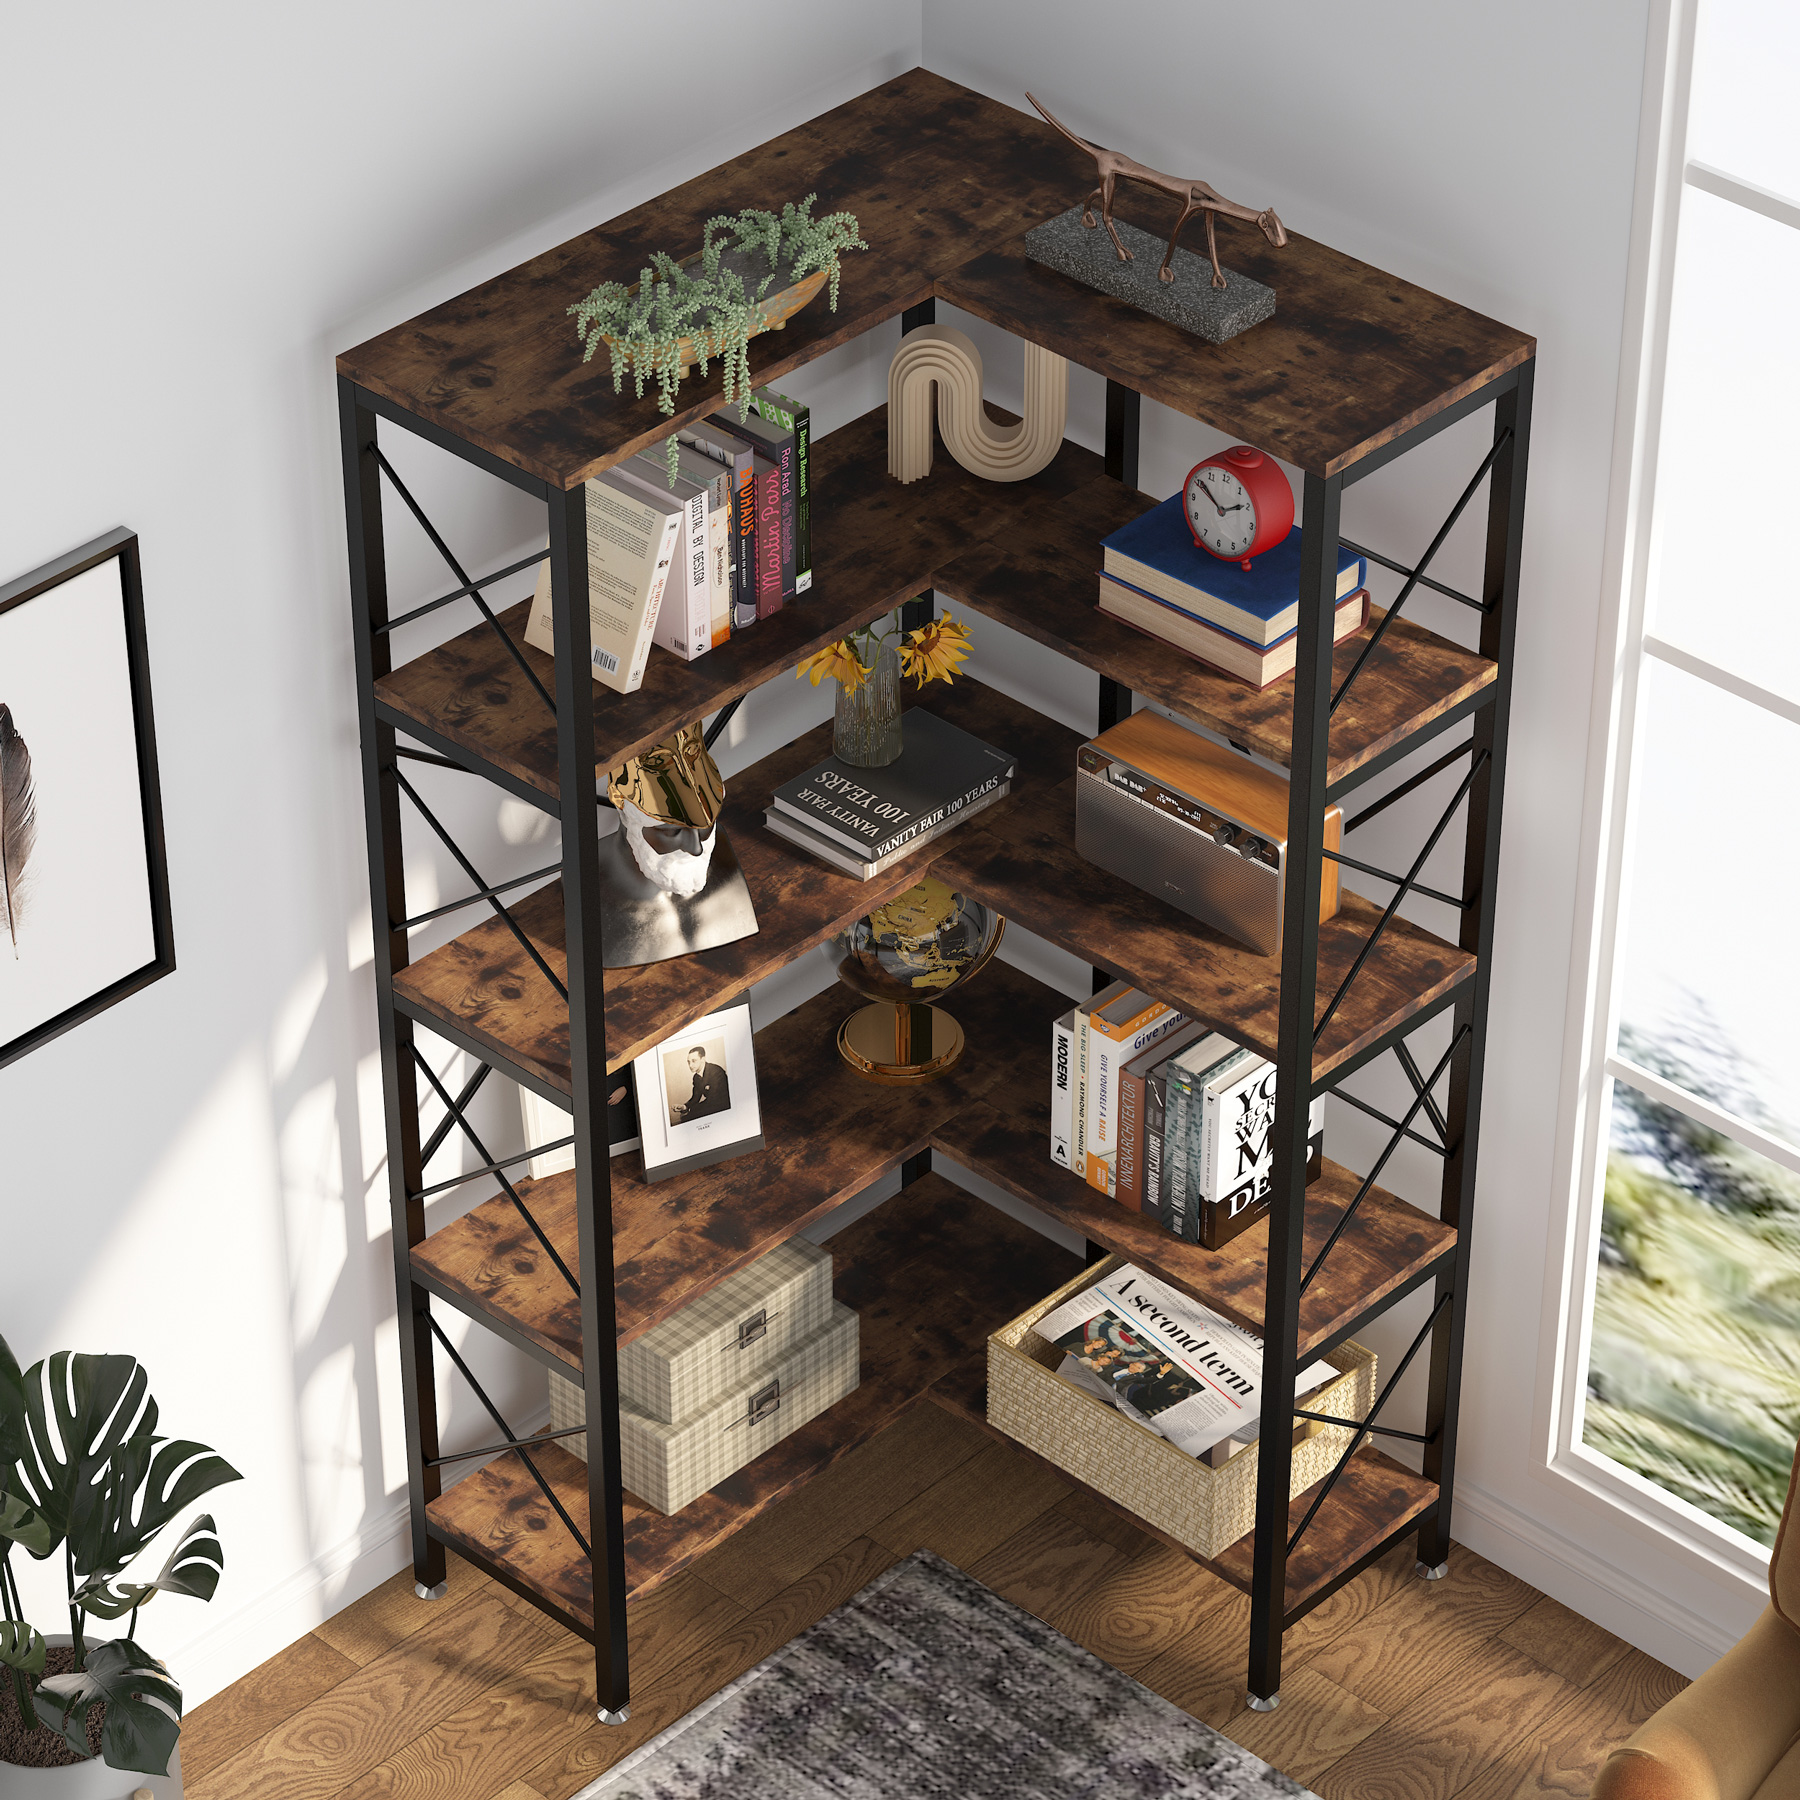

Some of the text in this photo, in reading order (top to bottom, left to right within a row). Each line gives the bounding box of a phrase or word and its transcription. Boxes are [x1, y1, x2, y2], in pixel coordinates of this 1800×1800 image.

[781, 447, 791, 471] Ron
[798, 429, 808, 458] Design
[782, 471, 791, 496] Arad
[799, 457, 808, 497] Research
[1208, 472, 1215, 482] 11
[1222, 474, 1230, 484] 12
[1237, 487, 1242, 495] 1
[739, 466, 754, 537] BAUHAUS
[762, 470, 779, 522] Parr
[1191, 493, 1196, 501] 9
[1245, 502, 1251, 511] 2
[691, 494, 704, 534] DIGITAL
[1194, 512, 1199, 520] 8
[1249, 522, 1254, 531] 3
[692, 535, 704, 549] BY
[1203, 528, 1208, 537] 7
[1216, 539, 1221, 548] 6
[1231, 542, 1236, 551] 5
[1242, 537, 1247, 545] 4
[693, 551, 705, 587] DESIGN
[762, 521, 780, 591] Martin
[797, 788, 880, 838] VANITY FAIR
[814, 771, 911, 824] 100 YEARS
[876, 775, 999, 858] VANITY FAIR 100 YEARS
[882, 849, 907, 867] Public
[910, 837, 926, 850] and
[958, 799, 991, 820] Housing
[1134, 1013, 1187, 1050] Give you
[1135, 1004, 1167, 1027] GORDO
[1057, 1033, 1069, 1091] MODERN
[1100, 1054, 1108, 1073] GIVE
[1099, 1074, 1107, 1110] YOURSELF
[1236, 1070, 1277, 1115] YO
[1098, 1118, 1106, 1141] RAISE
[1235, 1096, 1275, 1131] SECR
[1235, 1110, 1274, 1144] WA
[1119, 1080, 1136, 1191] INNENARCHITEKTUR
[1147, 1134, 1161, 1206] GRAVITY'S RAINBOW
[1233, 1131, 1270, 1181] M
[1228, 1176, 1273, 1219] DE
[1109, 1278, 1137, 1296] A
[1128, 1294, 1211, 1354] second
[1199, 1351, 1255, 1397] term
